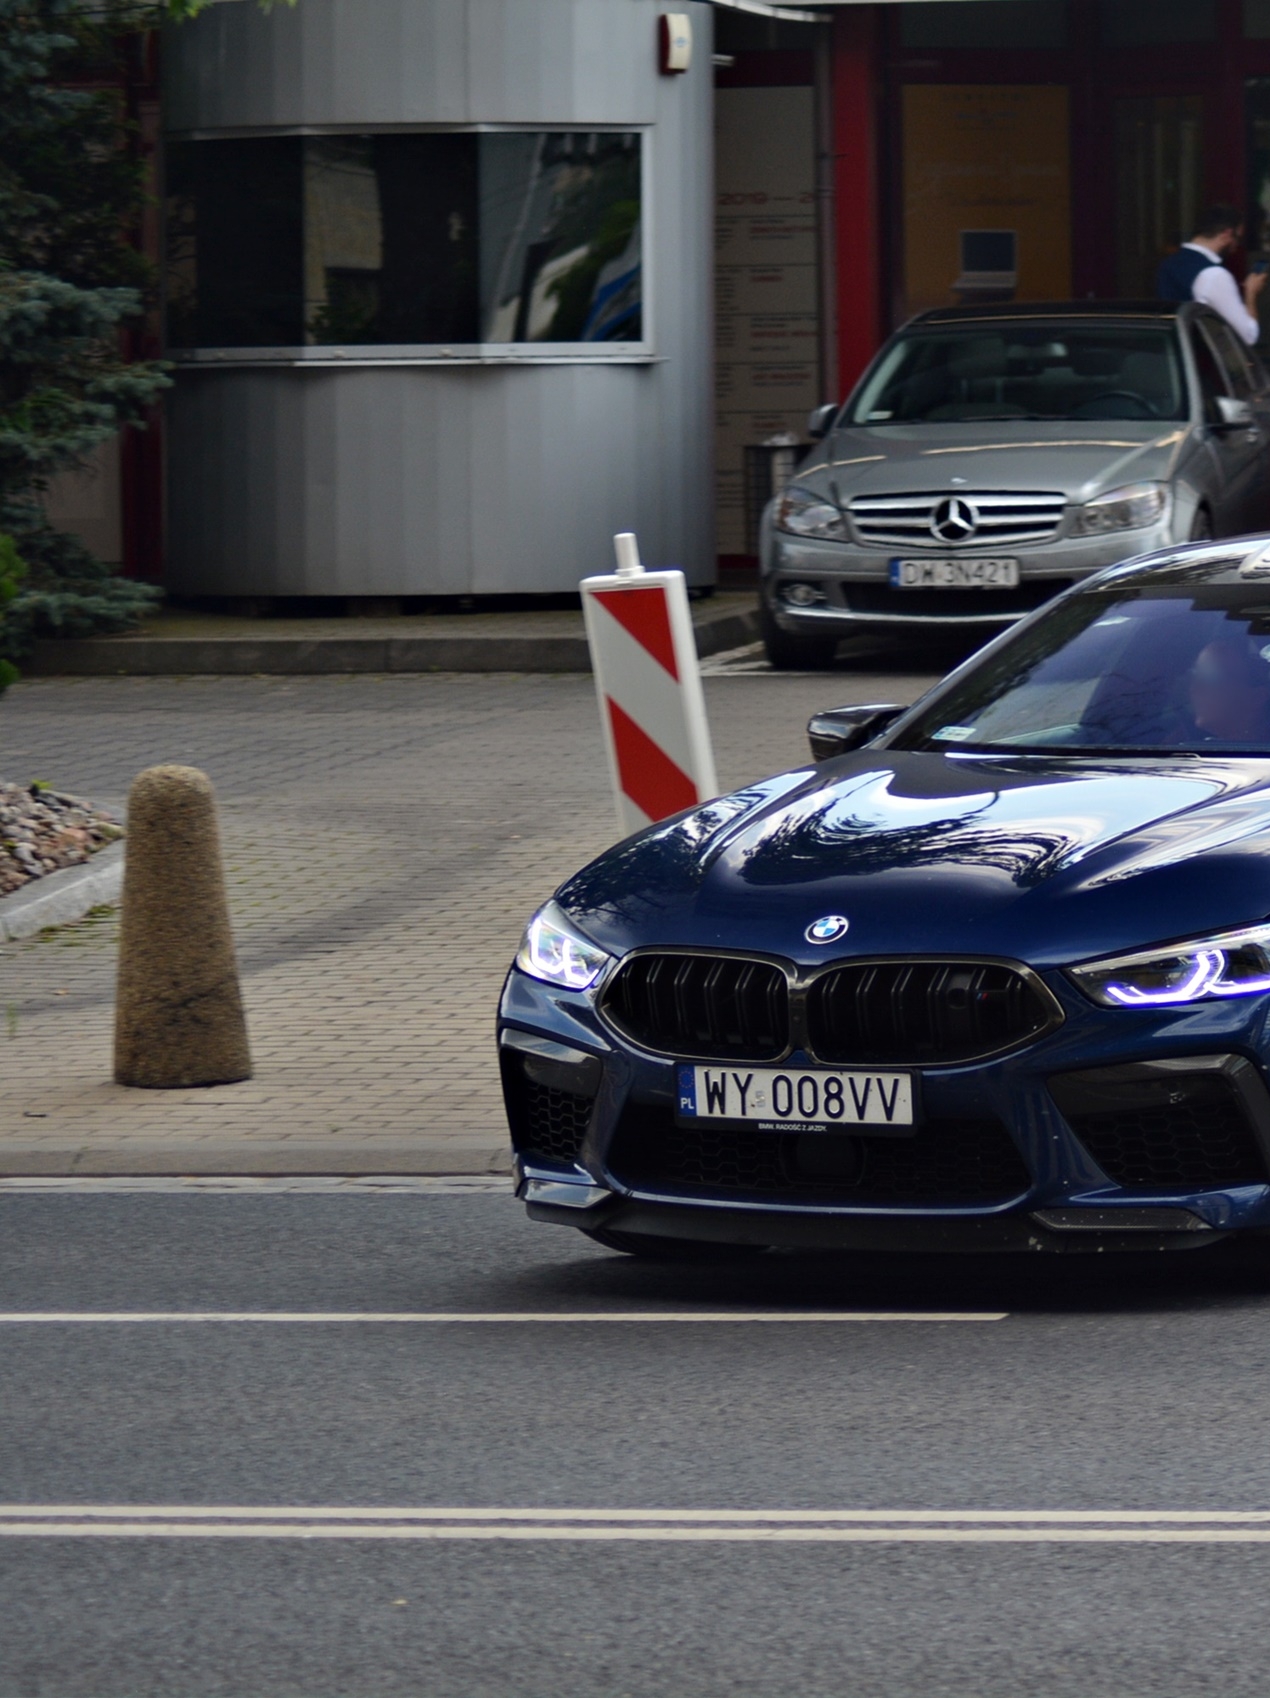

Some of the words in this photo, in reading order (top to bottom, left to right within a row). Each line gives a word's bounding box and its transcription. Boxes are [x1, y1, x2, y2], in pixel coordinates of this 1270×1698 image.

[680, 1098, 694, 1109] PL
[704, 1071, 753, 1116] WY
[772, 1074, 900, 1122] 008VV
